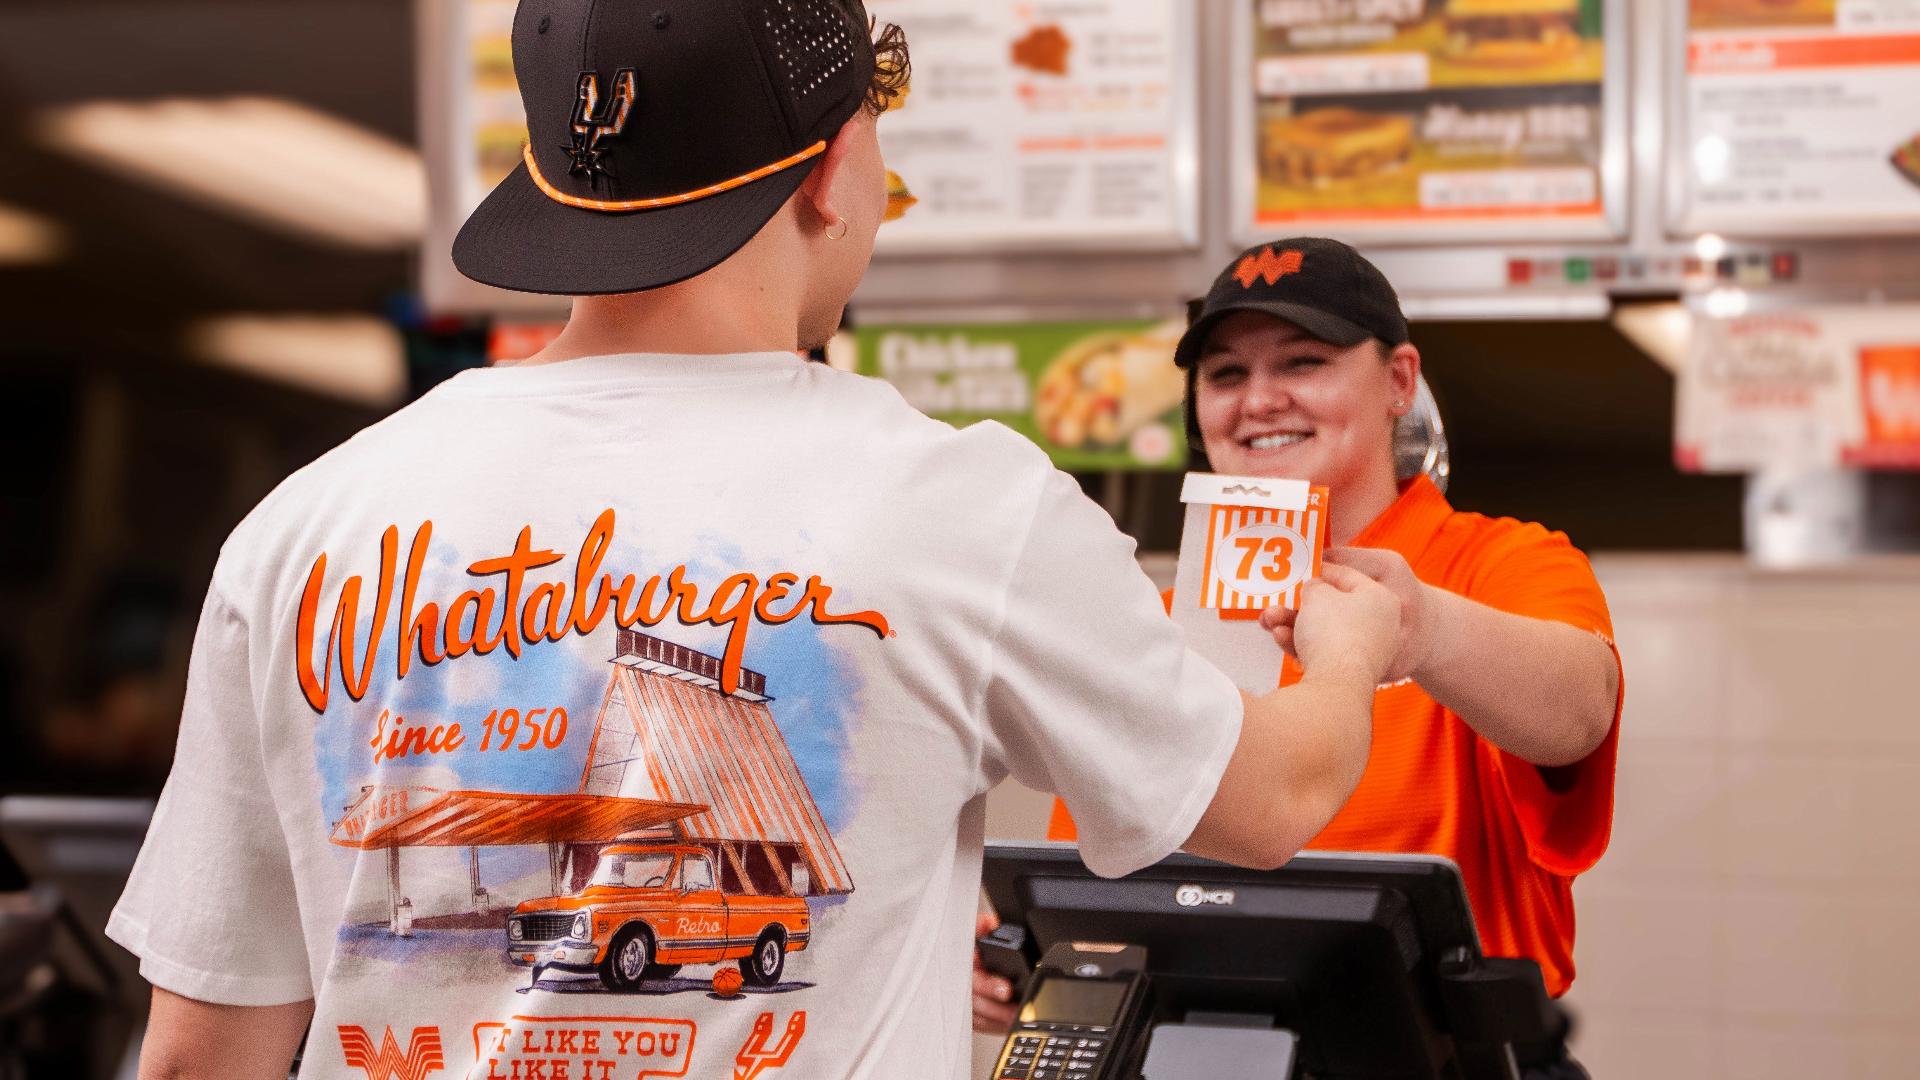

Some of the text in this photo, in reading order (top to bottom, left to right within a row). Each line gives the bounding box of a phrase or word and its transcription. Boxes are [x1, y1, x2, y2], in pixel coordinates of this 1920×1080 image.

[1234, 536, 1294, 582] 73
[296, 507, 890, 714] Whataburger
[371, 706, 568, 763] Since 1950
[676, 916, 722, 935] Retro
[522, 1029, 601, 1054] LIKE
[613, 1030, 681, 1058] YOU
[487, 1058, 617, 1080] LIKE IT
